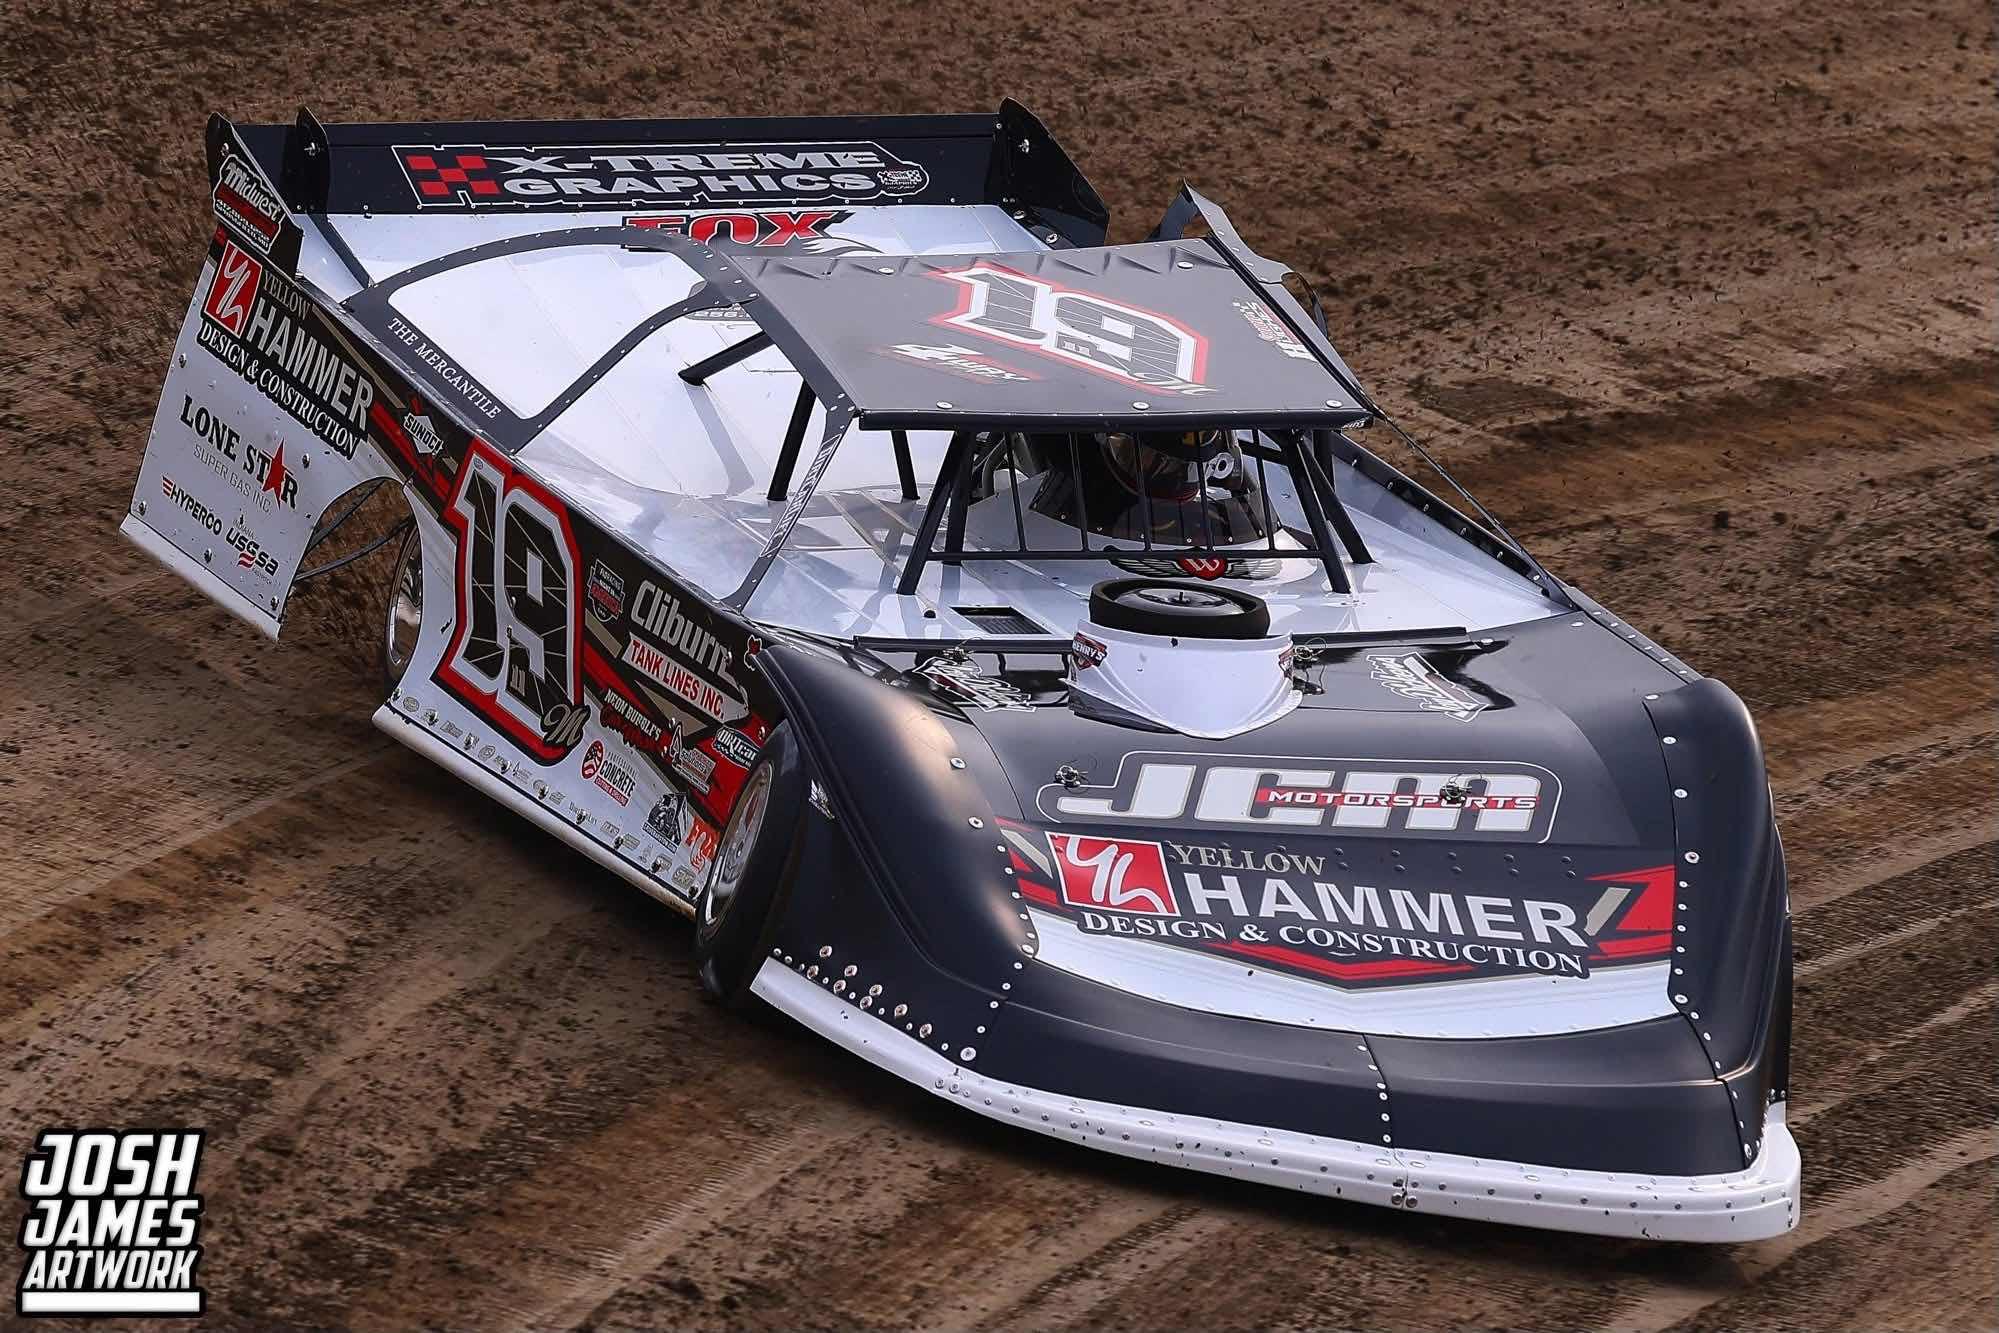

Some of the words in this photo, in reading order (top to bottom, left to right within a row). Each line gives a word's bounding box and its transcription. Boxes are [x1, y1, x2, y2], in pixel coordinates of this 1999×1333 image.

[498, 151, 886, 172] X-TREME
[502, 173, 877, 194] GRAPHICS
[263, 269, 311, 321] YELLOW
[199, 322, 250, 373] DESIGN
[247, 359, 259, 380] &
[259, 367, 362, 457] CONSTRUCTION
[246, 297, 374, 432] HAMMER
[387, 317, 419, 346] THE
[414, 342, 502, 419] MERCANTILE
[180, 394, 241, 463] LONE
[193, 443, 229, 479] SUPER
[229, 472, 251, 497] GAS
[170, 483, 223, 536] HYPERCO
[448, 451, 576, 744] 19
[630, 579, 730, 677] Cliburn
[604, 688, 630, 713] NEON
[630, 639, 663, 677] TANK
[662, 661, 701, 701] LINES
[699, 685, 725, 719] INC.
[599, 760, 636, 797] CONCRETE
[1268, 789, 1538, 810] MOTORSPORTS
[1171, 843, 1326, 876] YELLOW
[1183, 872, 1589, 948] HAMMER
[1079, 912, 1228, 940] DESIGN
[1239, 923, 1269, 943] &
[1278, 924, 1585, 974] CONSTRUCTION
